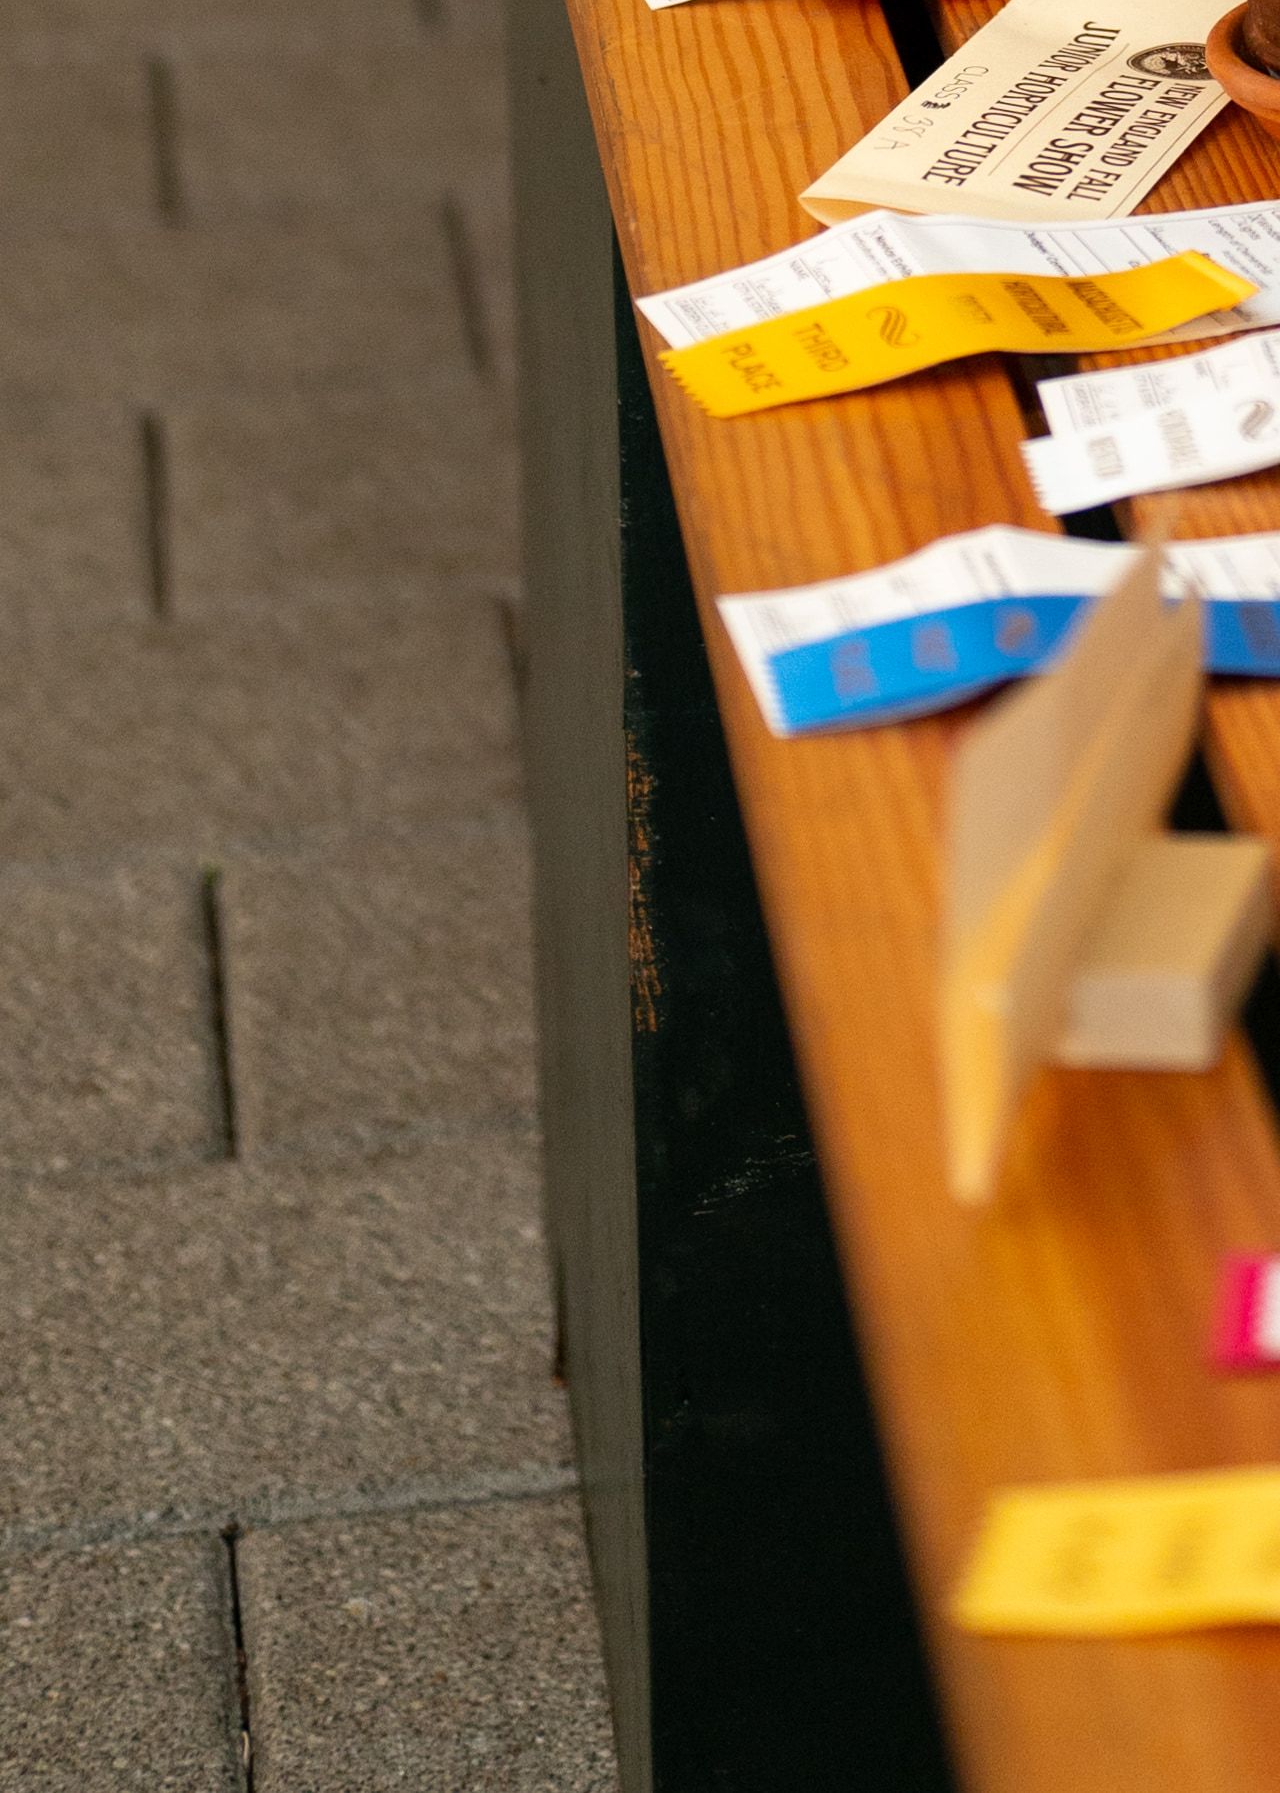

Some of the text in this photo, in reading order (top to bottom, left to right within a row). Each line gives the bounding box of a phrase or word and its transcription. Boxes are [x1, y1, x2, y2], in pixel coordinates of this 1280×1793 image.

[921, 20, 1122, 187] JUNIOR HORTICULTURE
[934, 65, 989, 100] CLASS
[1012, 74, 1162, 197] FLOWER SHOW
[1066, 82, 1207, 202] NEW ENGLAND FALL
[720, 342, 786, 395] PLACE
[792, 321, 850, 372] THIRD
